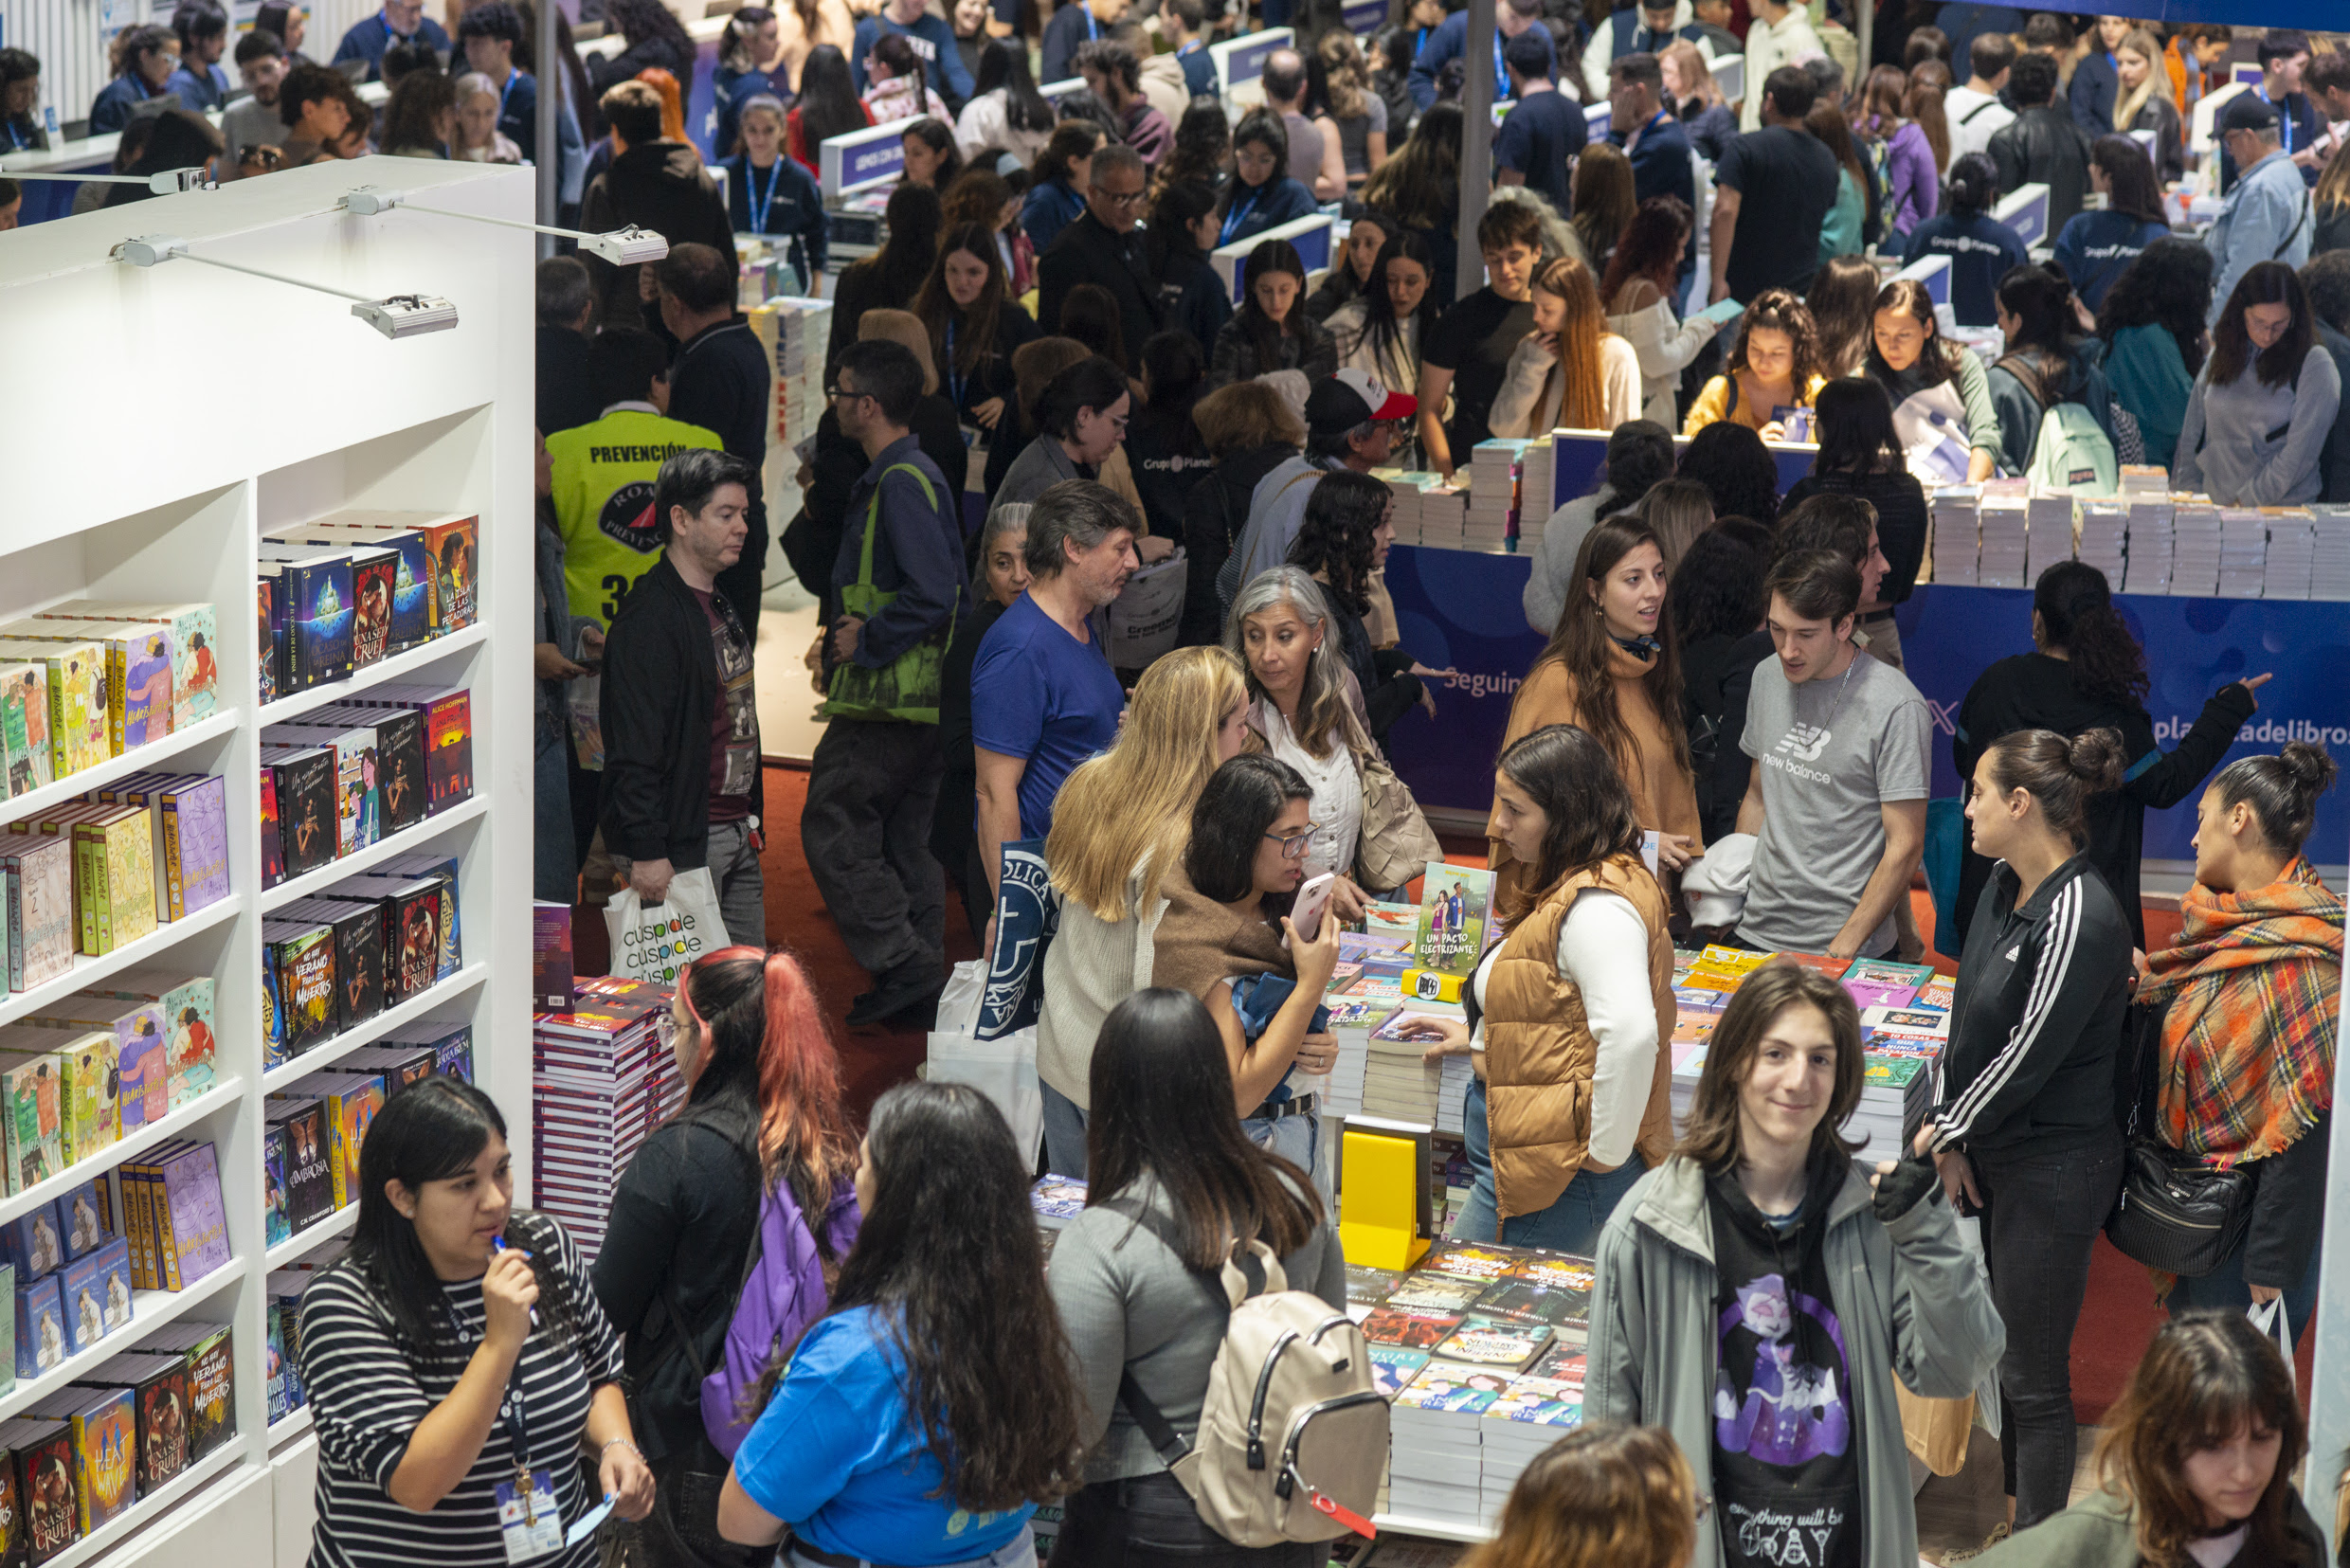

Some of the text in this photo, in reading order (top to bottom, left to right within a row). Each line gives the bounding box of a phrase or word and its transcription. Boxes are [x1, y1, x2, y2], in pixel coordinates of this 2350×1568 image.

[614, 484, 656, 508] ROA
[605, 521, 663, 548] PREVENC
[446, 585, 471, 604] LA ISLA
[448, 596, 469, 614] DE LAS
[442, 604, 474, 627] PECADORAS
[354, 638, 385, 664] CRUEL
[1443, 666, 1522, 697] Seguin
[432, 695, 468, 714] ALICE HOFFMAN
[1762, 752, 1831, 784] new balance
[183, 857, 226, 891] HEARTSTOPPER
[624, 912, 696, 946] cúspide
[1426, 933, 1469, 944] UN PACTO
[303, 952, 311, 963] NO
[626, 934, 701, 968] cúspide
[1419, 944, 1474, 956] ELECTRIZANTE
[296, 954, 328, 980] VERANO
[403, 965, 433, 994] CRUEL
[296, 980, 332, 1010] MUERTOS
[121, 1076, 166, 1107] HEARTSTOPPER
[177, 1222, 224, 1259] HEARTSTOPPER
[193, 1355, 226, 1386] VERANO
[201, 1356, 208, 1366] NO
[194, 1379, 230, 1415] MUERTOS
[95, 1433, 129, 1473] HEAT
[150, 1448, 184, 1482] CRUEL
[97, 1460, 126, 1500] WAVE
[1797, 1507, 1825, 1526] will
[1827, 1507, 1844, 1525] be
[35, 1517, 76, 1552] CRUEL
